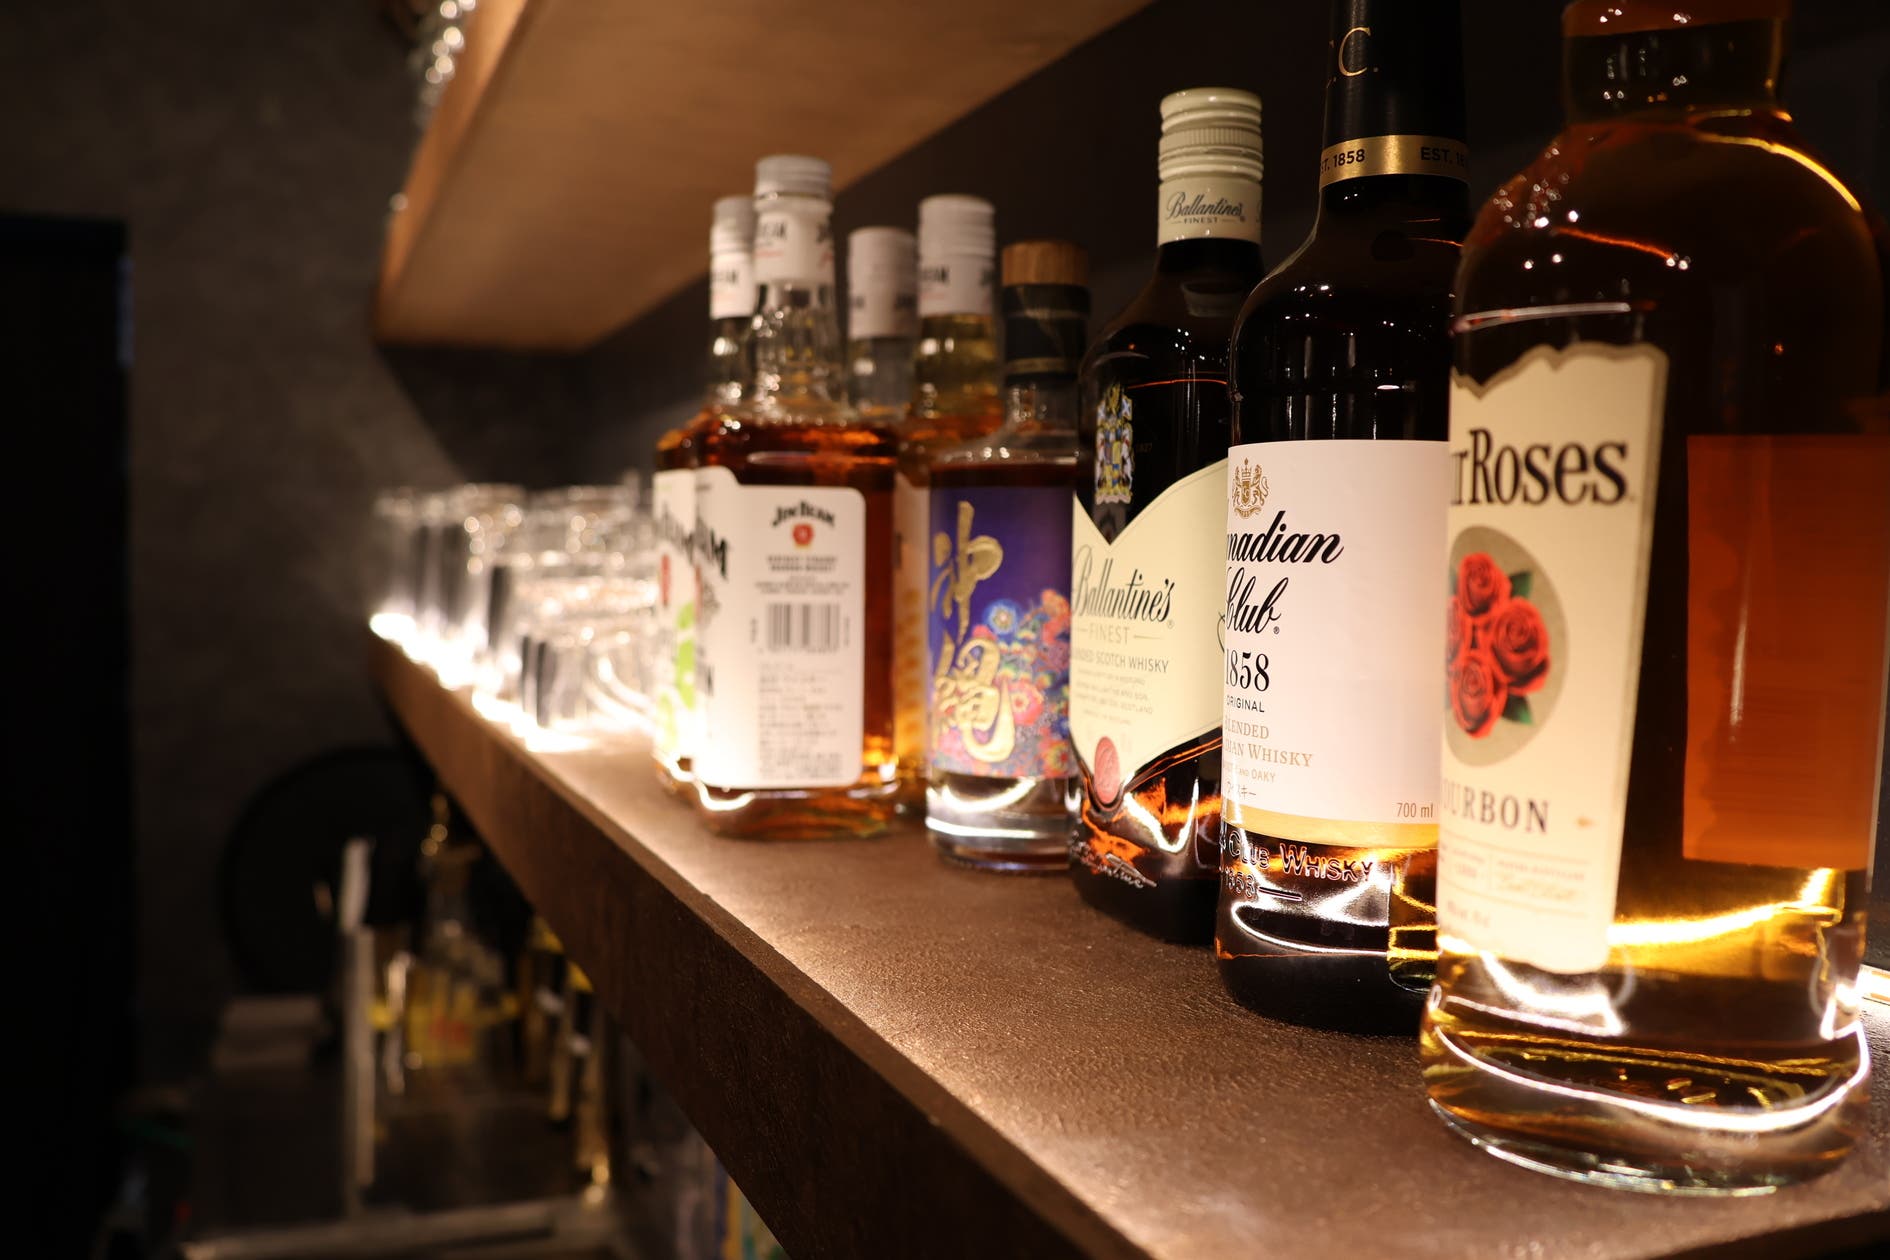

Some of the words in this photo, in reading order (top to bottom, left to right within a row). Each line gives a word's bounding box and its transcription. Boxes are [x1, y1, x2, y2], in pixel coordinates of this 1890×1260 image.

[1333, 149, 1366, 167] 1858
[1421, 146, 1453, 165] EST.
[1165, 191, 1243, 221] Ballantine's
[1183, 216, 1218, 225] FINEST
[1227, 510, 1345, 564] nadian
[1072, 544, 1176, 623] Ballantine's
[1088, 622, 1131, 645] FINEST
[1095, 650, 1126, 668] SCOTCH
[1128, 655, 1169, 674] WHISKY
[1225, 648, 1270, 692] 1858
[1247, 743, 1313, 768] WHISKY
[1251, 768, 1276, 783] OAKY
[1396, 802, 1417, 818] 700
[1420, 802, 1434, 818] ml
[1442, 778, 1550, 836] URBON
